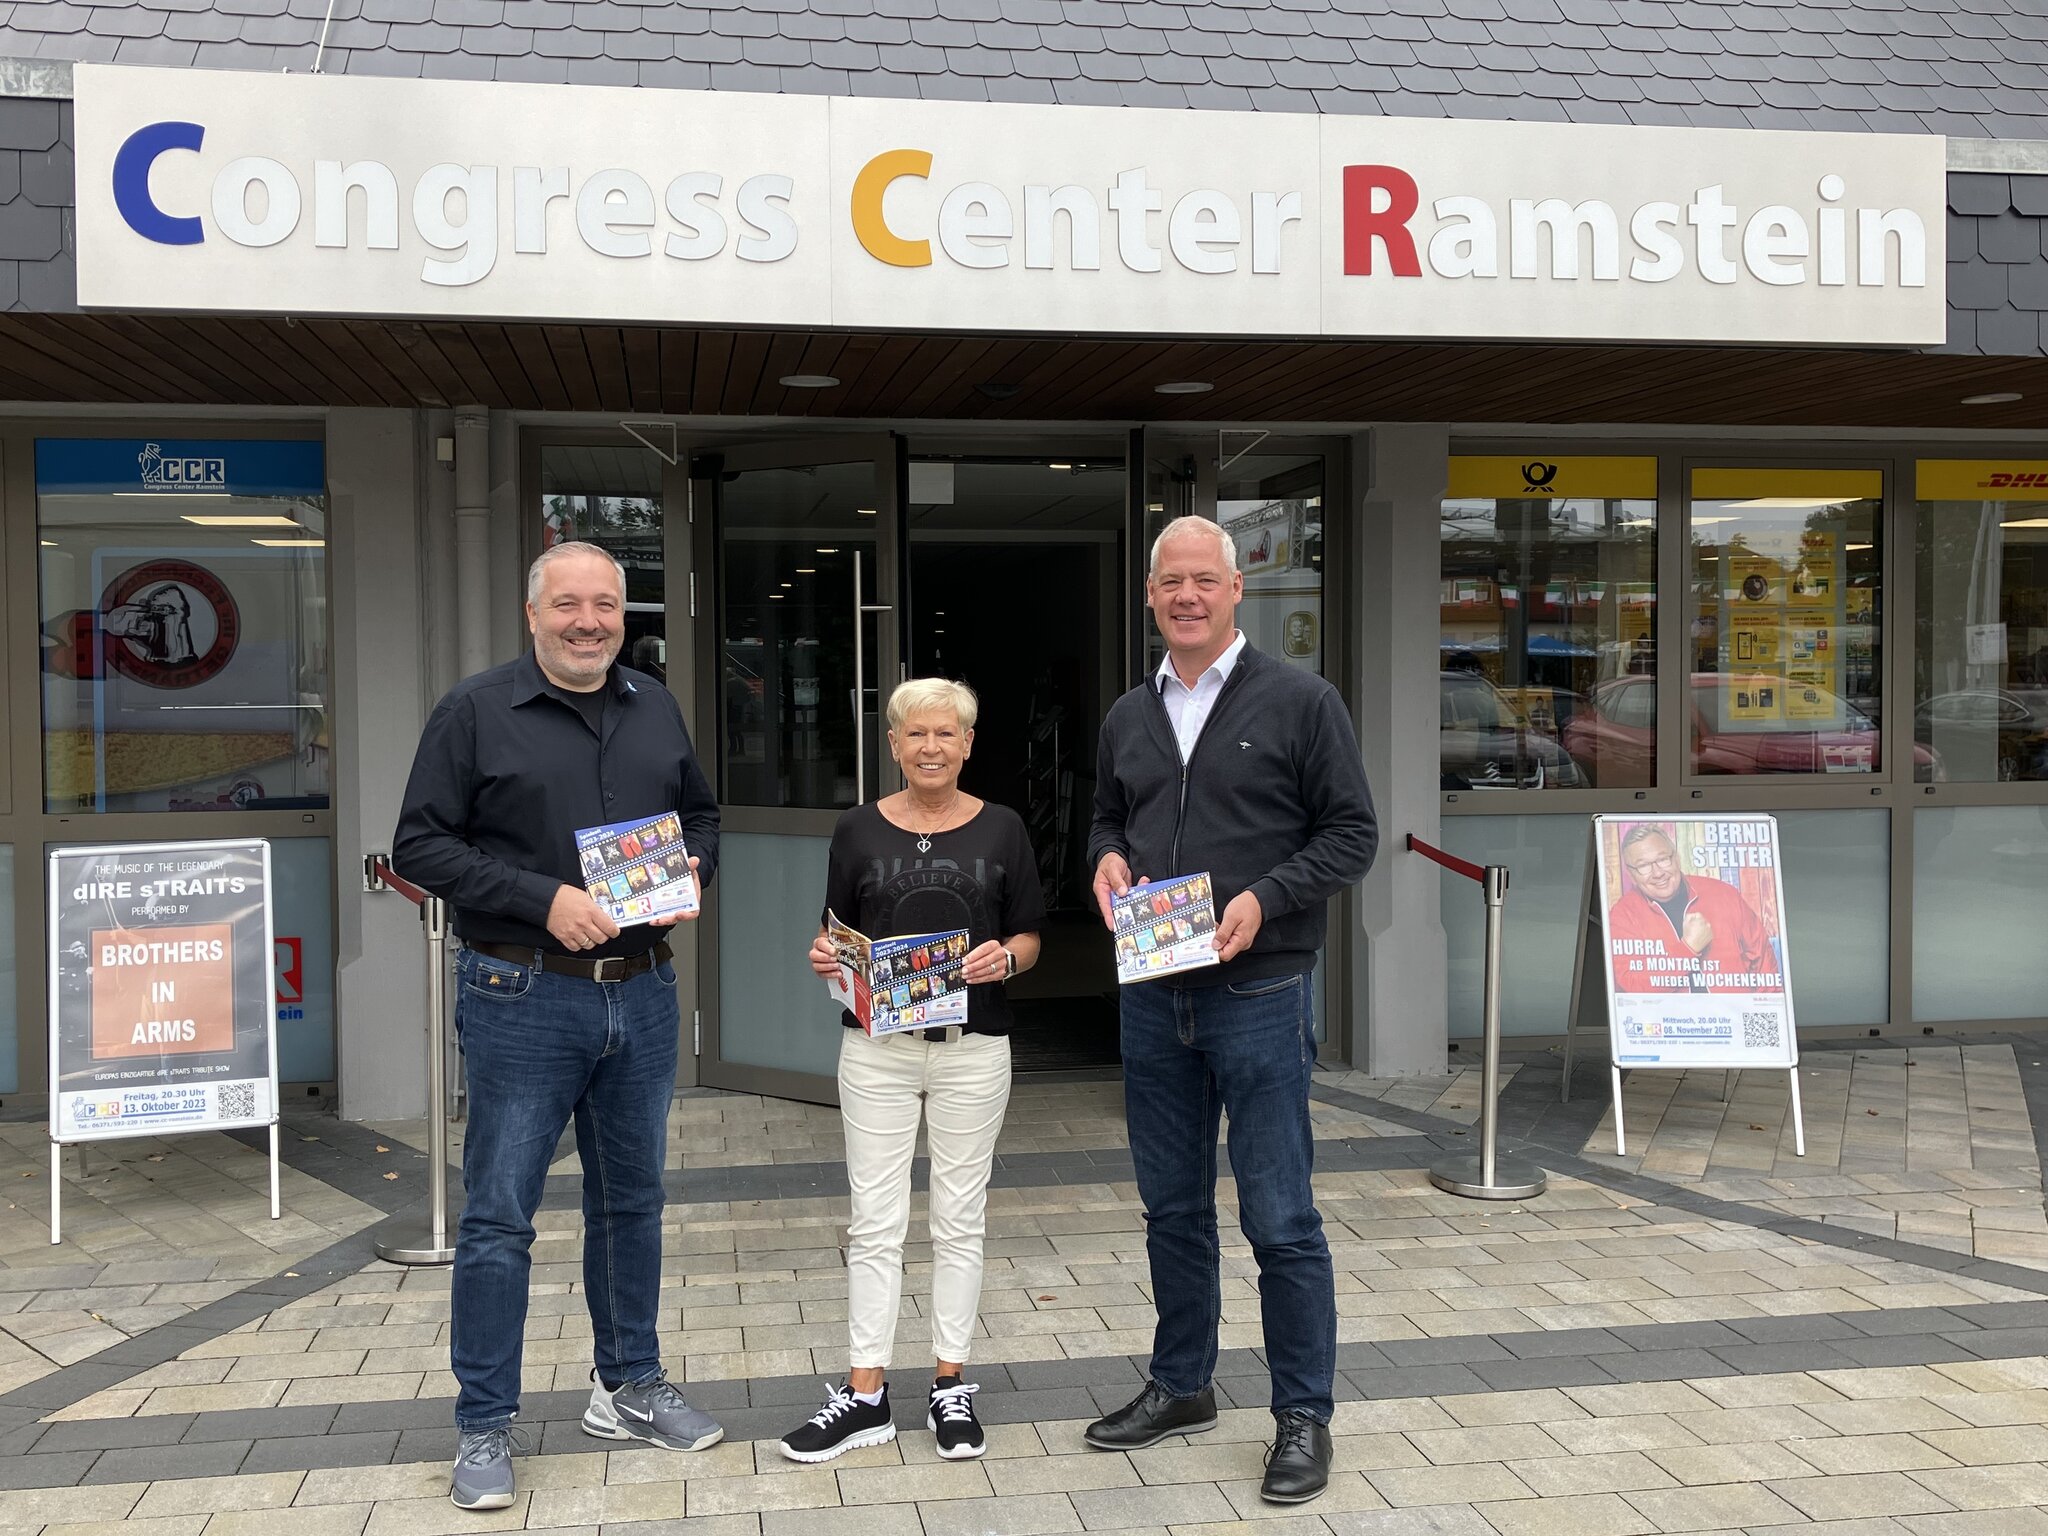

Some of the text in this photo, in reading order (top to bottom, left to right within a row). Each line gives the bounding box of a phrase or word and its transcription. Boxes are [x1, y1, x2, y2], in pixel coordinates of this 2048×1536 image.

[112, 119, 1927, 288] Congress Center Ramstein
[162, 459, 224, 483] CCR
[1704, 822, 1770, 844] BERND
[1692, 846, 1772, 868] STELTER
[95, 860, 224, 875] THE MUSIC OF THE LEGENDARY
[888, 872, 964, 900] BELIEVE
[131, 904, 189, 916] PERFORMED BY
[101, 939, 224, 967] BROTHERS
[875, 943, 909, 958] 2023-2024
[1612, 938, 1669, 957] HURRA,
[1629, 957, 1720, 972] AB MONTAG IST
[1650, 973, 1783, 987] WIEDER WOCHENENDE
[152, 981, 175, 1004] IN
[888, 1006, 925, 1026] CCR
[1663, 1017, 1695, 1025] Mittwoch,
[130, 1018, 196, 1045] ARMS
[1664, 1026, 1733, 1035] 08. November 2023
[94, 1070, 119, 1081] EUROPAS
[120, 1069, 155, 1080] EINZIGARTIGE
[192, 1065, 213, 1074] TRIBUTE
[215, 1064, 231, 1073] SHOW
[124, 1089, 206, 1102] Freitag, 20.30 Uhr
[124, 1098, 206, 1114] 13. Oktober 2023
